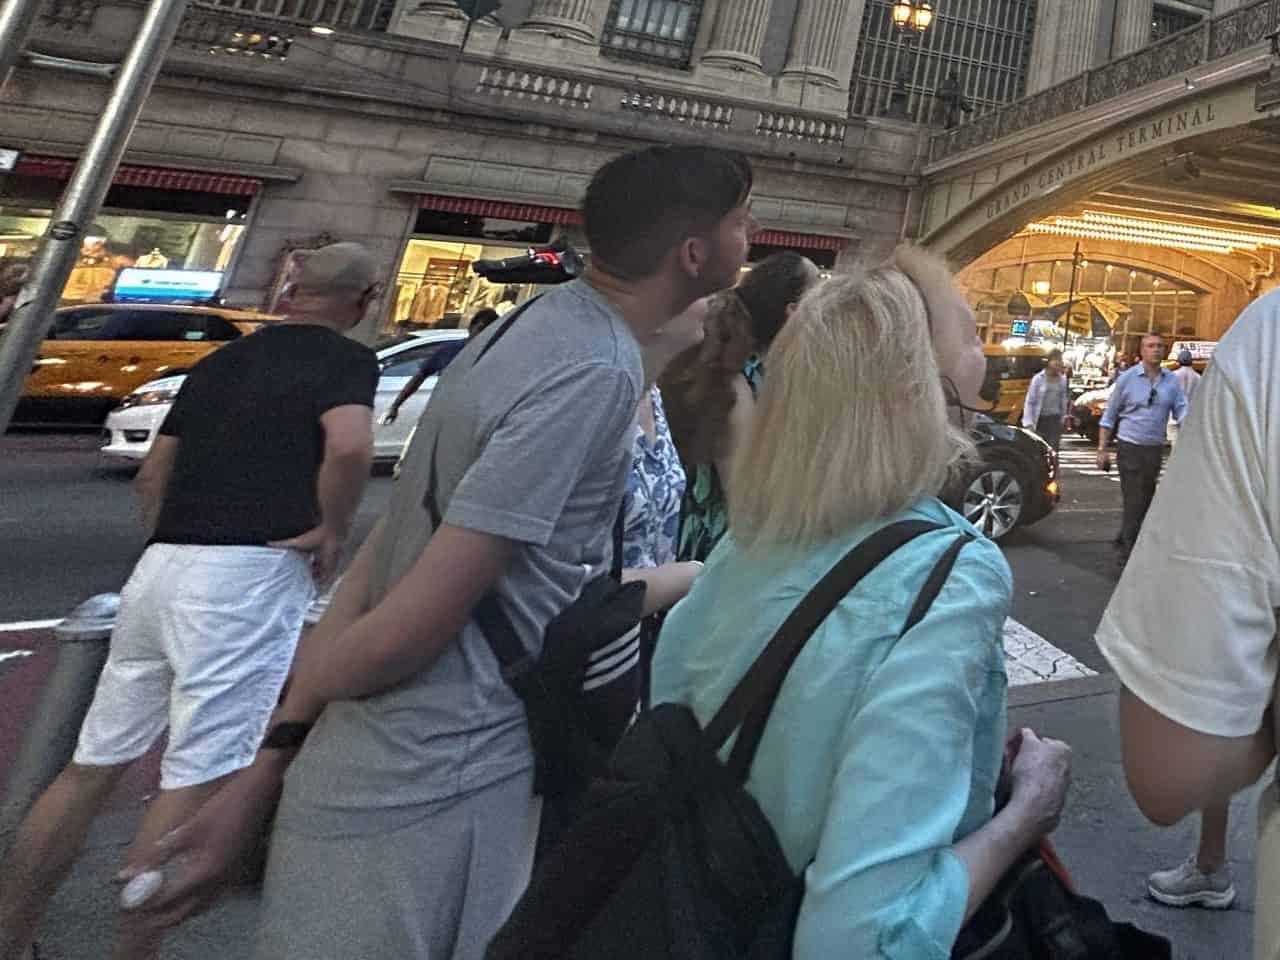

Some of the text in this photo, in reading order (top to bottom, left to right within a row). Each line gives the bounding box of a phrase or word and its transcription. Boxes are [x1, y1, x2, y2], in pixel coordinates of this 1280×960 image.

[986, 102, 1216, 219] GRAND CENTRAL TERMINAL
